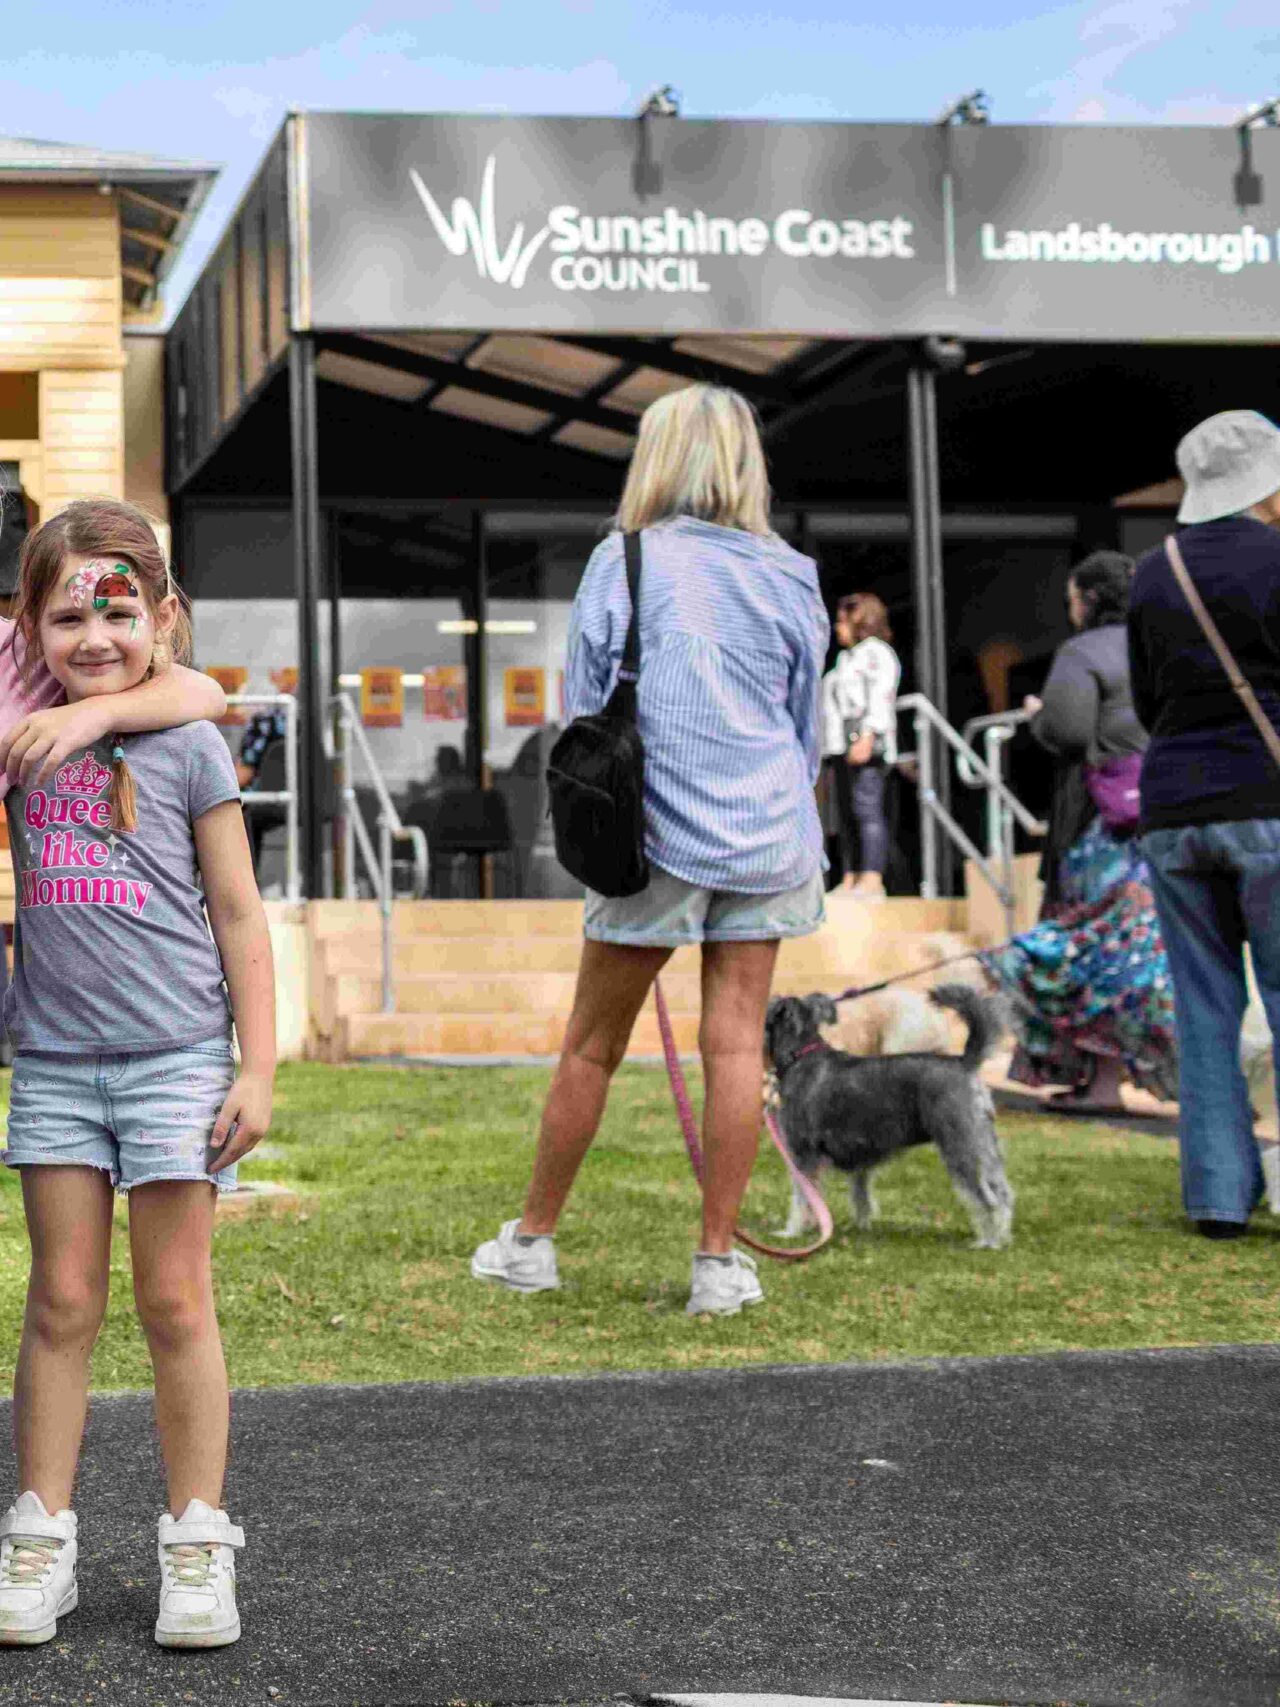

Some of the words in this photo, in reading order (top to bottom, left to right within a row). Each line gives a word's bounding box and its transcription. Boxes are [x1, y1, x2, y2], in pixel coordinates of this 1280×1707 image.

[549, 206, 769, 255] Sunshine
[775, 209, 916, 258] Coast
[982, 222, 1271, 273] Landsborough
[550, 257, 711, 292] COUNCIL
[25, 790, 135, 834] Quee
[41, 830, 109, 869] like
